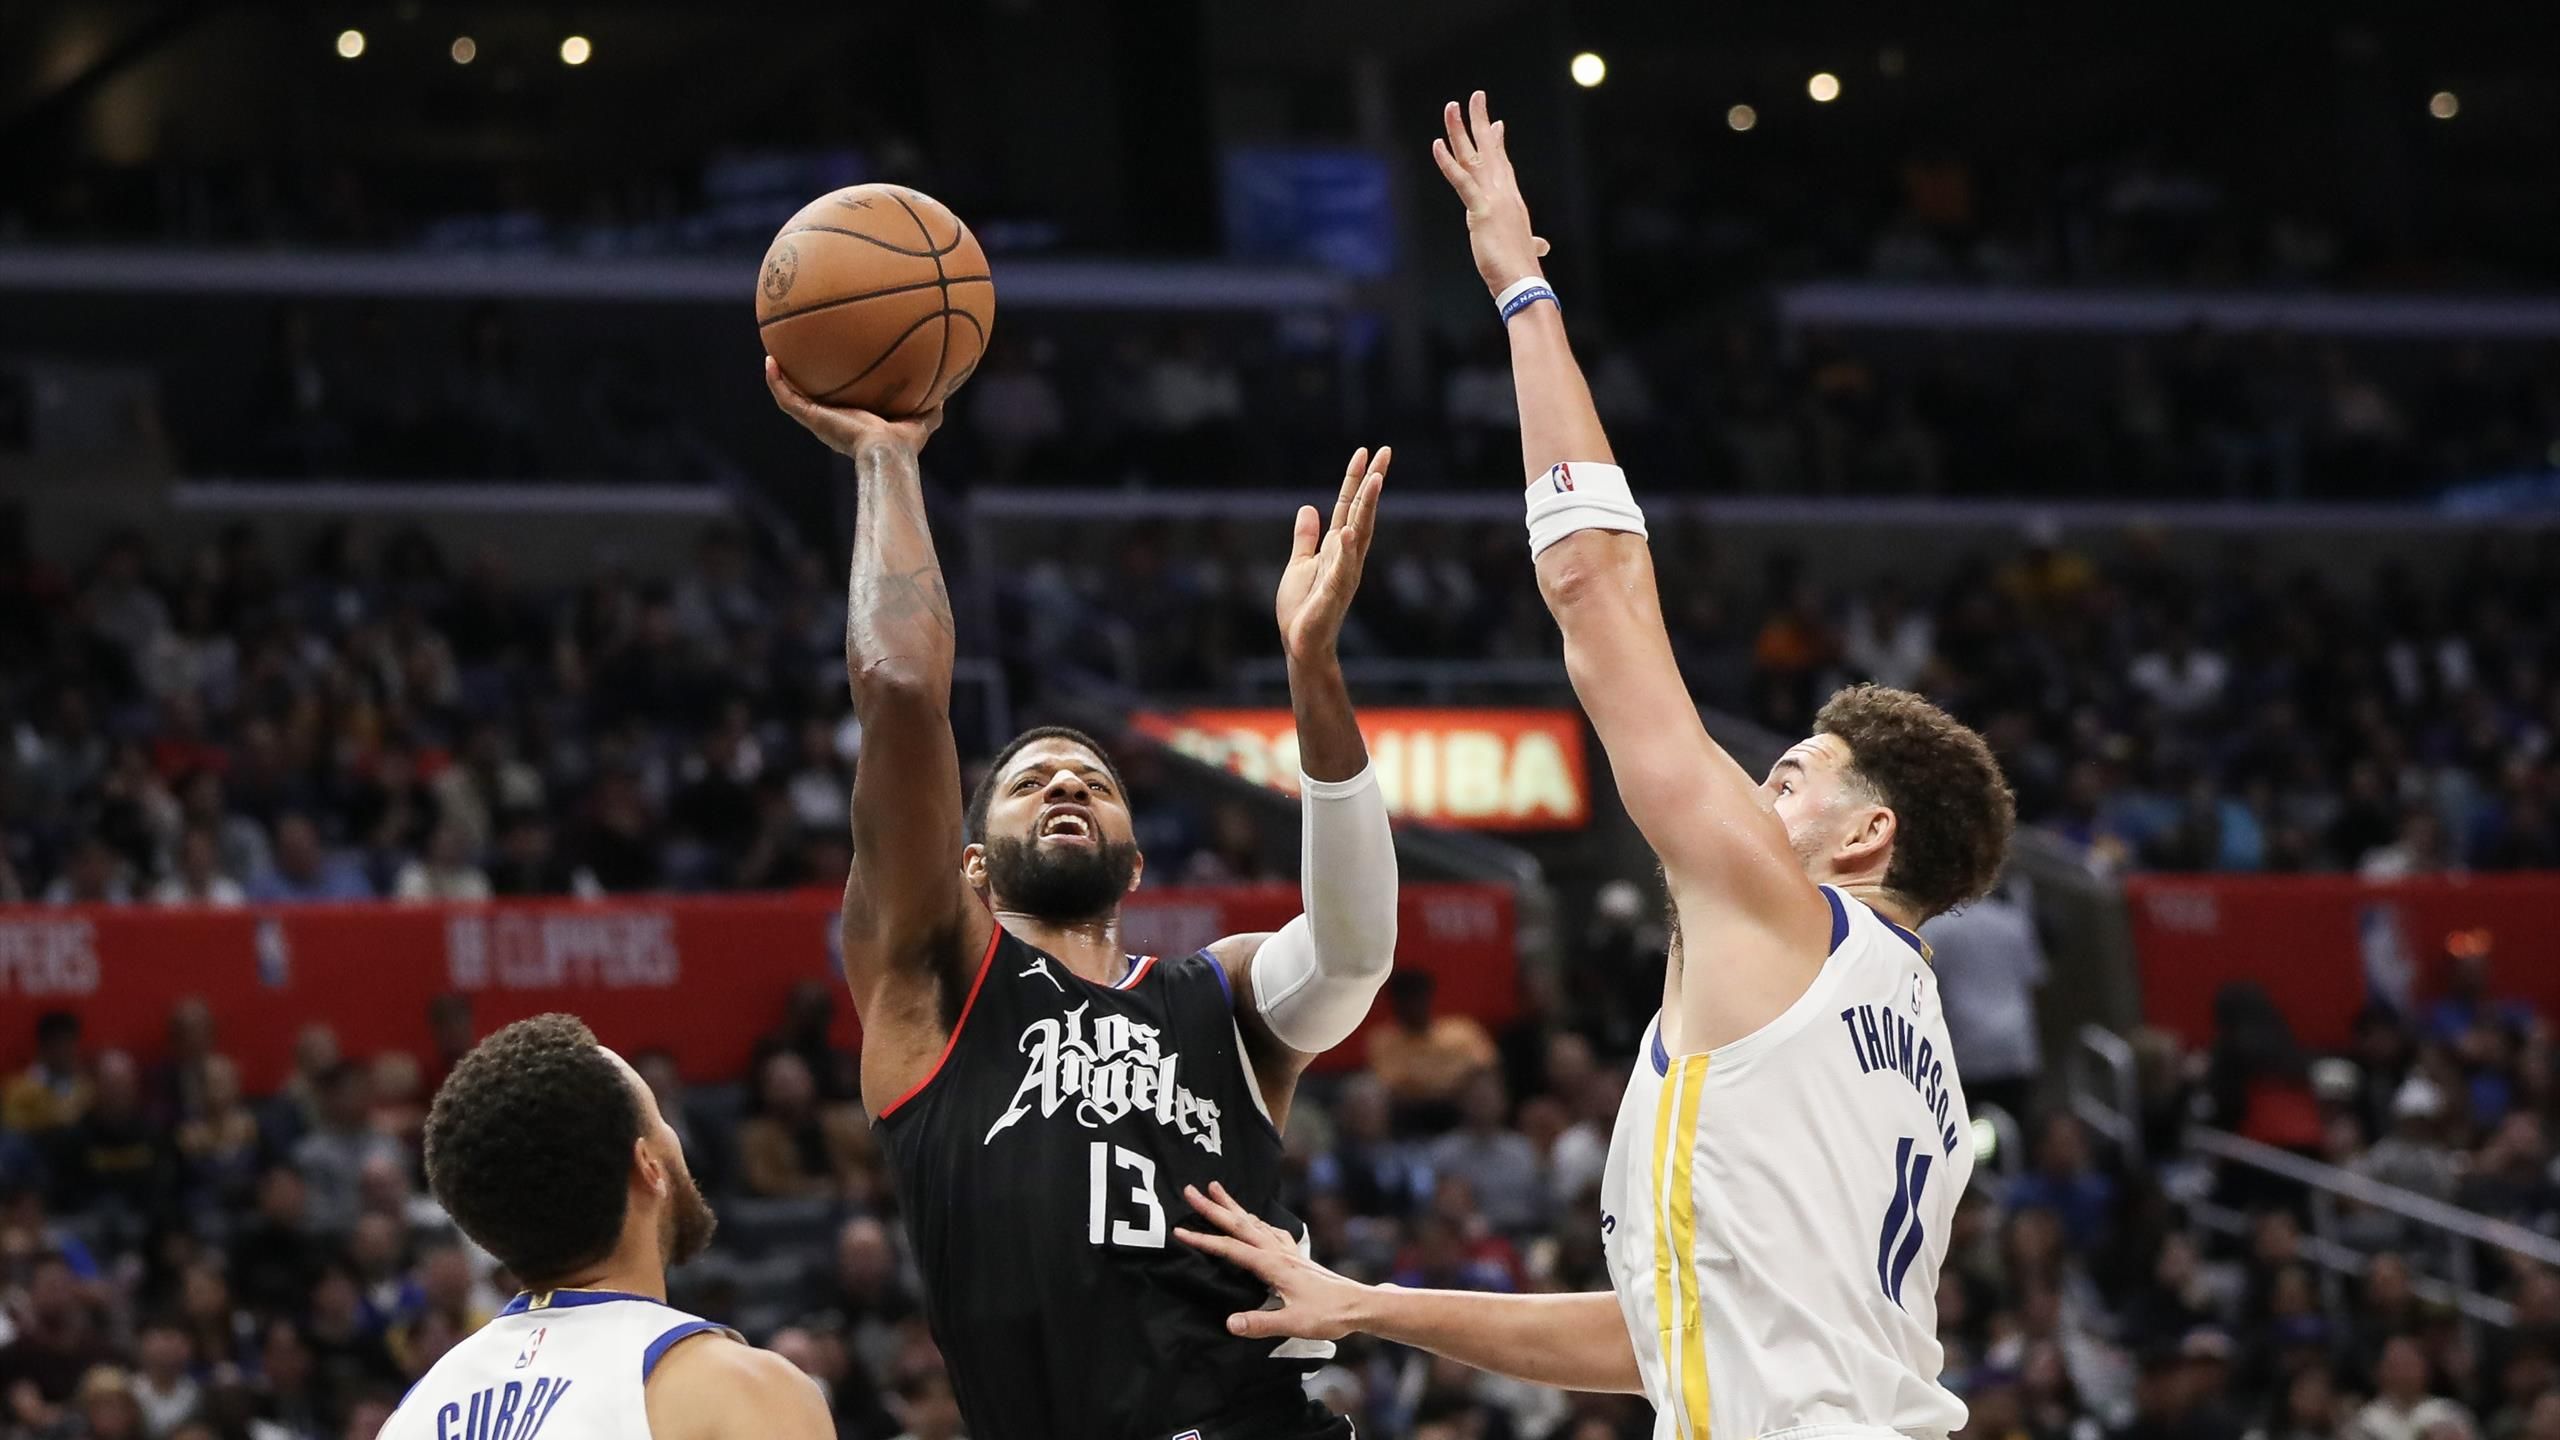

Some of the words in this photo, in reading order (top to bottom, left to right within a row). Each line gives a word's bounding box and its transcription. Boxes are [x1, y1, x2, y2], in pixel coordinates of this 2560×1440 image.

[984, 1017, 1222, 1157] Angeles
[1063, 1000, 1161, 1067] Los
[1841, 1004, 1958, 1158] THOMPSON
[1089, 1142, 1166, 1248] 13
[1877, 1137, 1932, 1313] 11
[437, 1377, 572, 1440] CURRY
